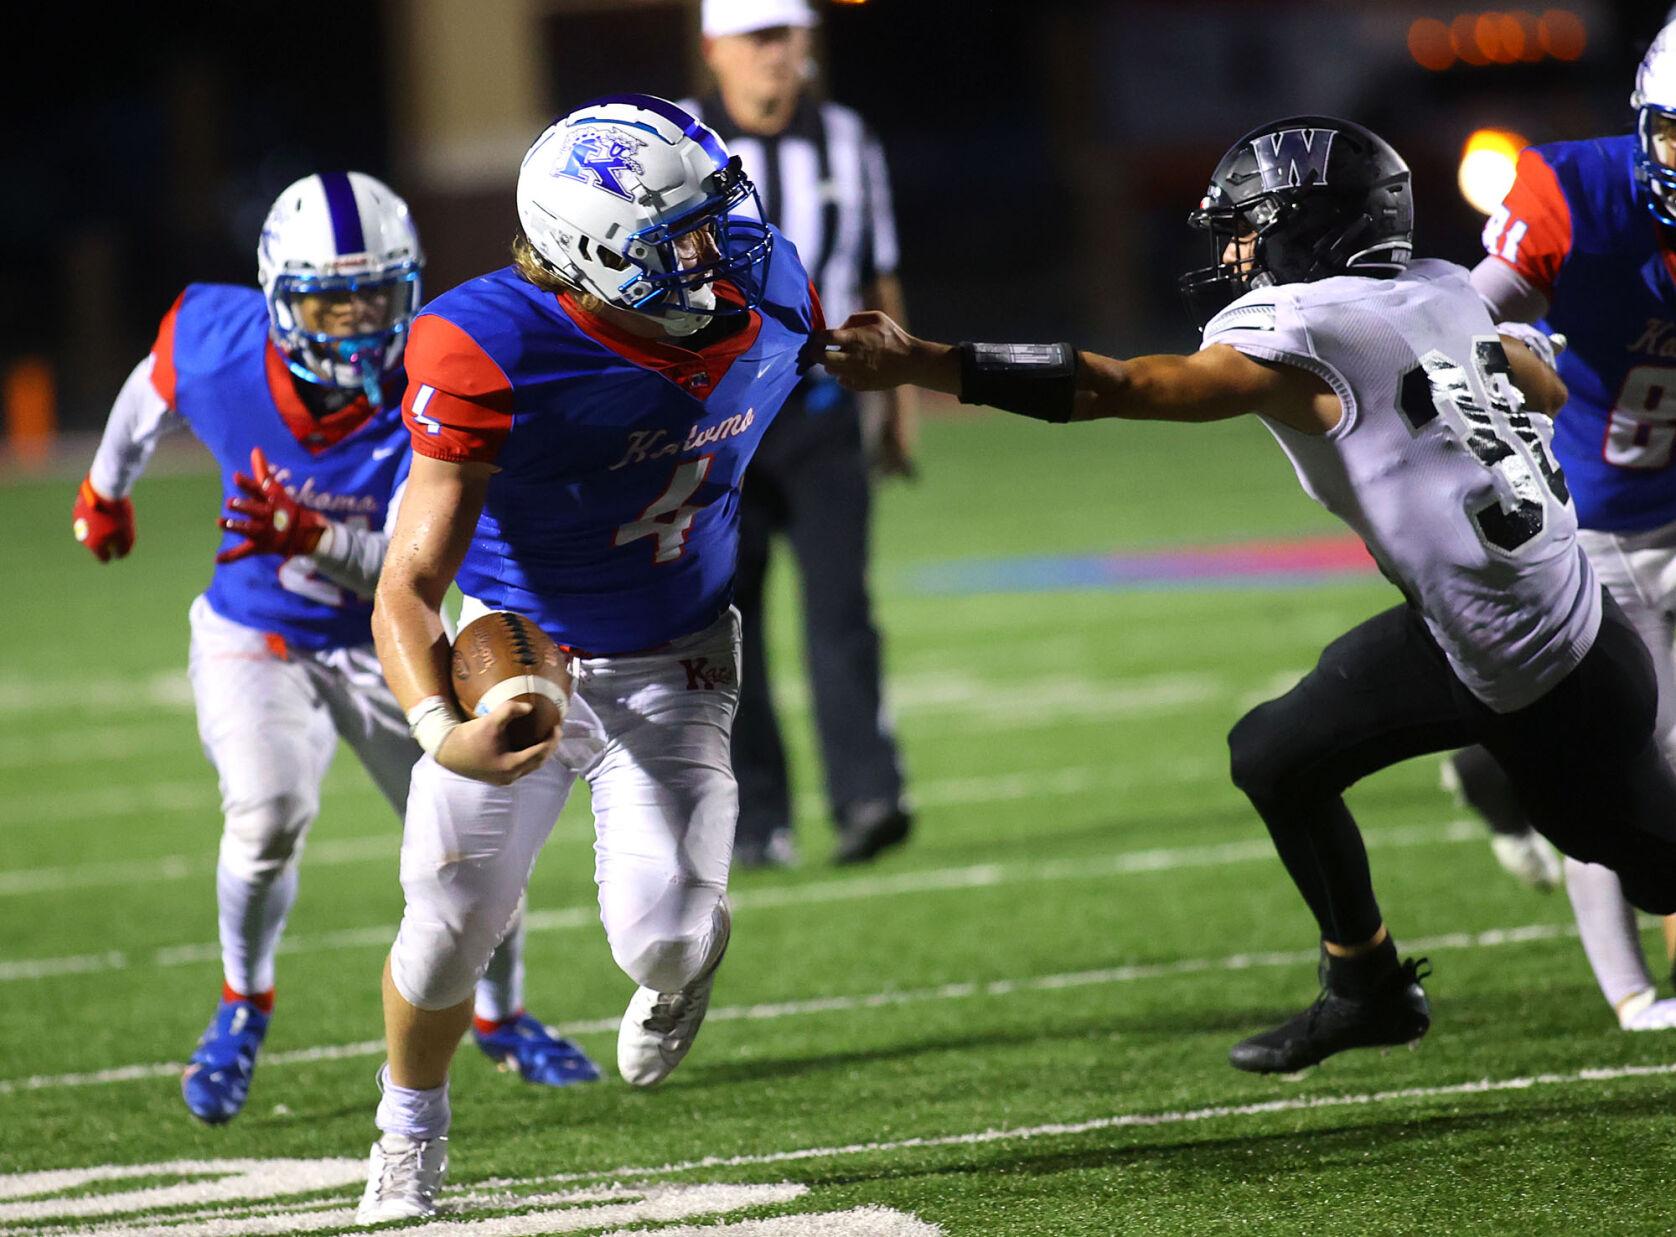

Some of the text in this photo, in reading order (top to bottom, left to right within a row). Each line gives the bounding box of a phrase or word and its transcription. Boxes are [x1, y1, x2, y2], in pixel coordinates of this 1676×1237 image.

[552, 138, 638, 204] K
[1249, 128, 1339, 192] W
[411, 383, 442, 436] 4
[608, 452, 716, 566] 4
